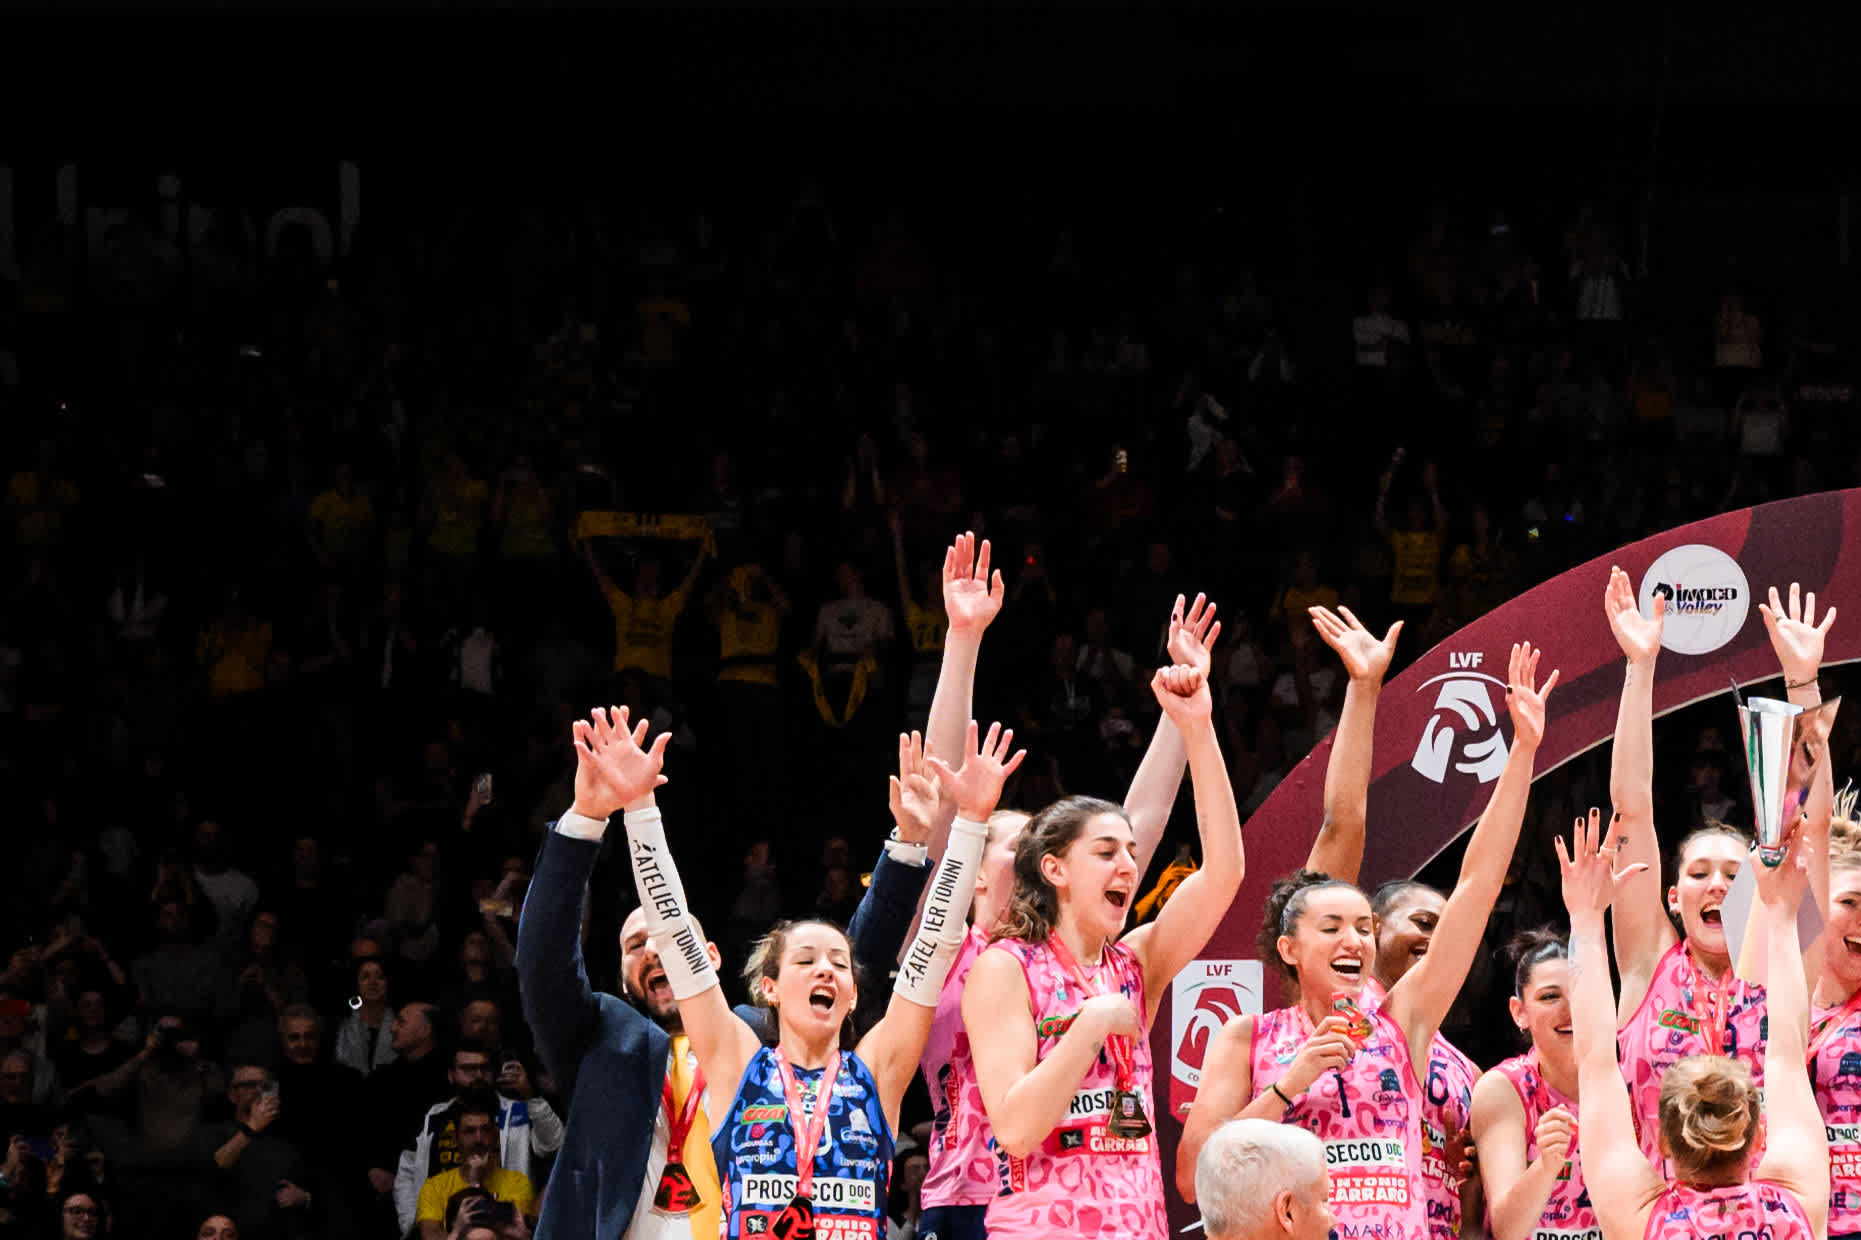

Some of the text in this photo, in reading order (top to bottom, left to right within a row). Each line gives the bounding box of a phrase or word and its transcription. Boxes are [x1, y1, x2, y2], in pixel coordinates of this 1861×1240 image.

[1449, 651, 1484, 669] LVF
[634, 855, 710, 975] ATELIER TONINI
[1206, 964, 1233, 977] LVF
[1325, 1142, 1382, 1164] SECCO
[747, 1179, 872, 1202] PROSCCO DOC
[813, 1217, 872, 1231] TONIO
